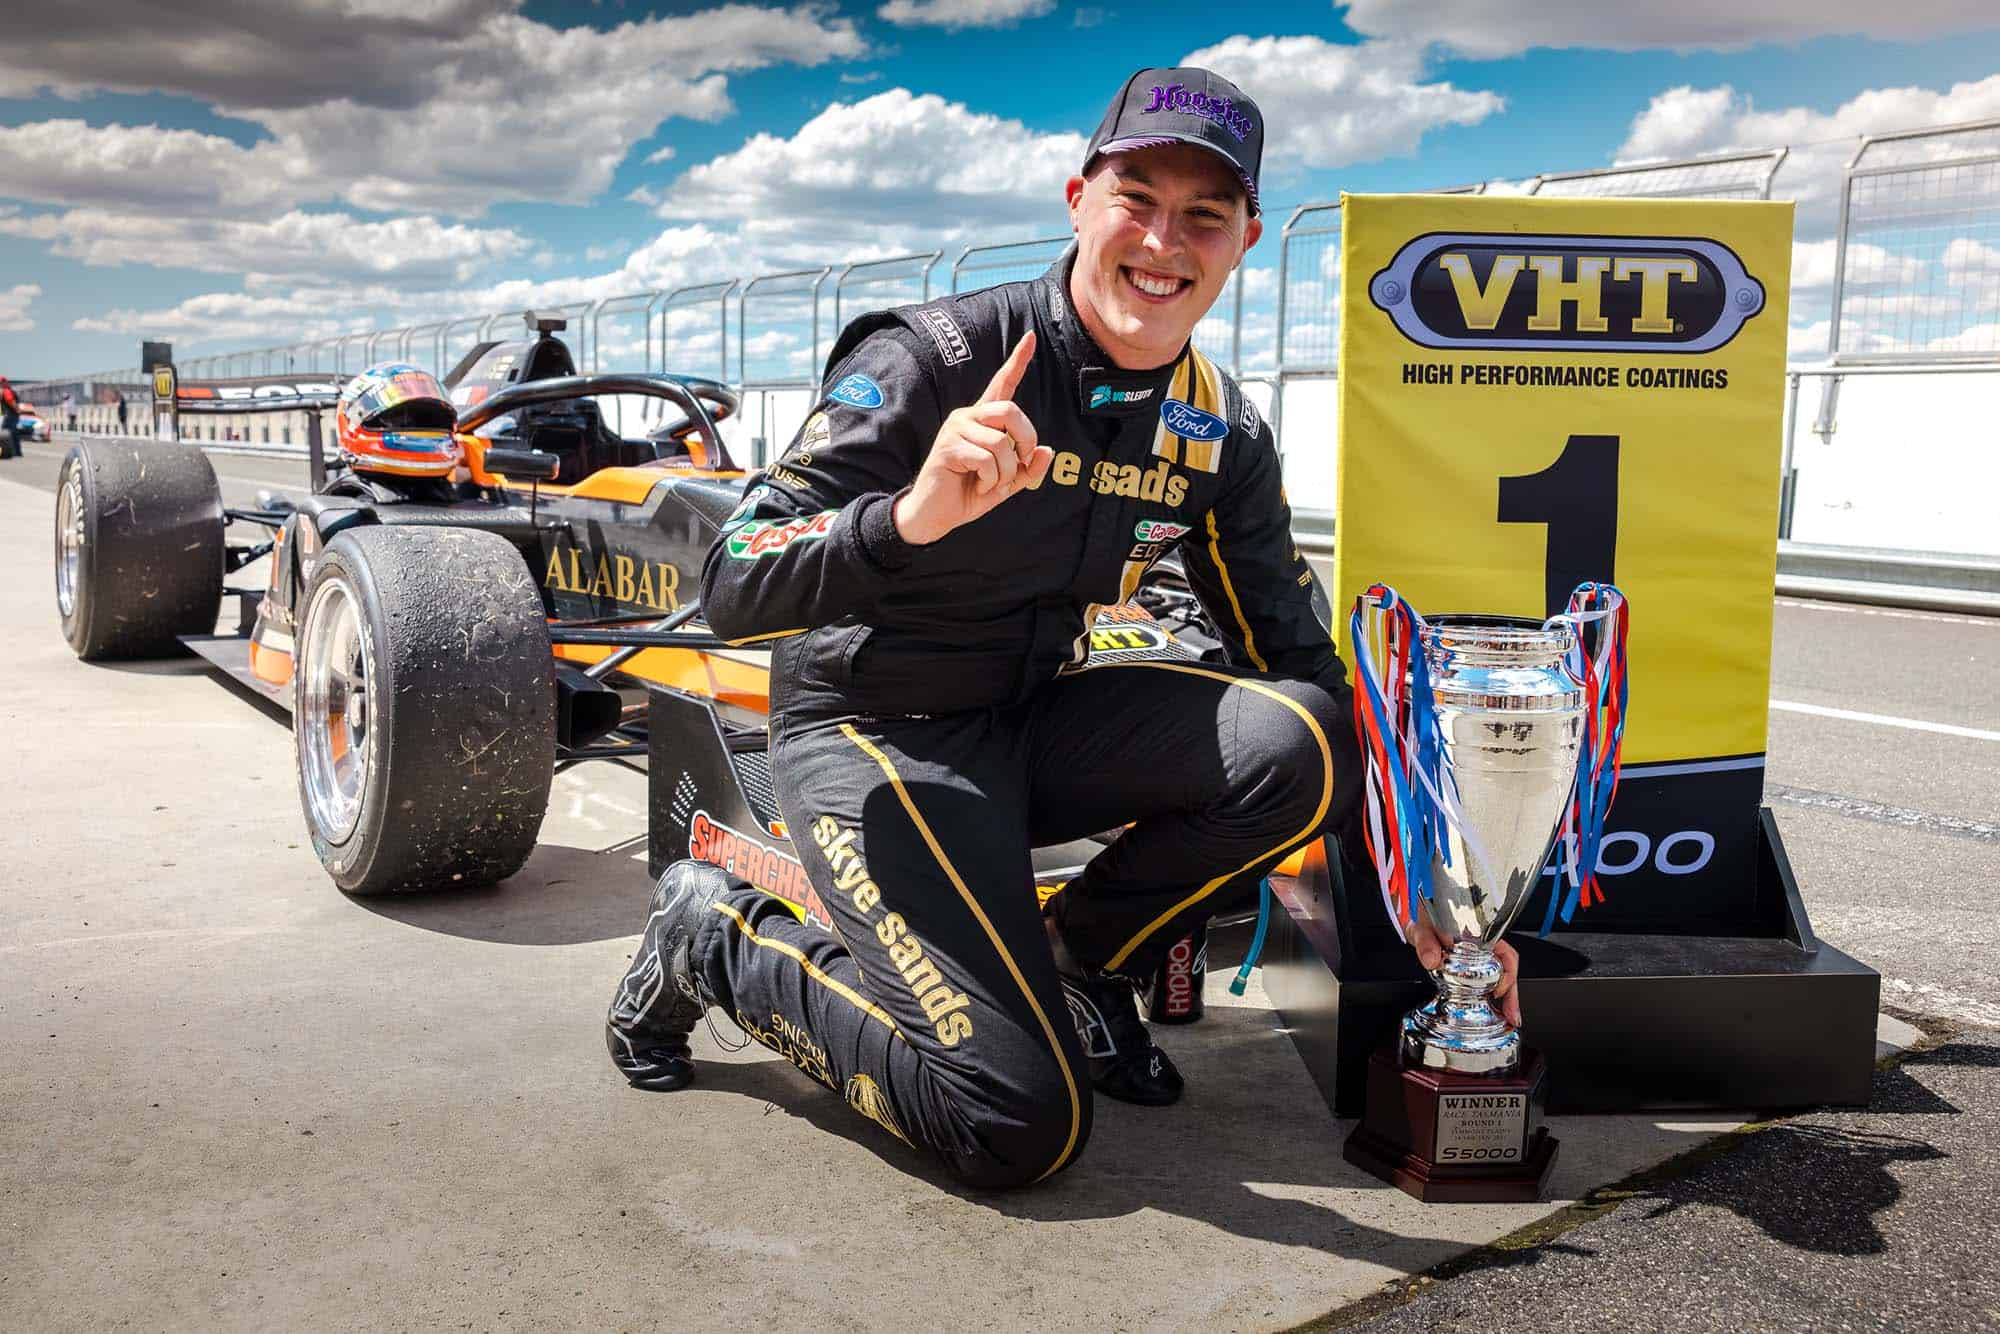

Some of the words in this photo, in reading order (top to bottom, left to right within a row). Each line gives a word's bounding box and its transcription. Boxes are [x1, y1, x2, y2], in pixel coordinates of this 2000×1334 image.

[1440, 253, 1698, 334] VHT
[1401, 363, 1454, 385] HIGH
[1460, 364, 1620, 388] PERFORMANCE
[1626, 367, 1729, 390] COATINGS
[1168, 404, 1211, 437] Ford
[543, 544, 681, 613] ALABAR
[1497, 434, 1621, 706] 1
[1091, 629, 1152, 651] HT
[812, 815, 882, 914] skye
[874, 911, 974, 1047] sands
[1445, 1097, 1521, 1109] WINNER
[1460, 1119, 1495, 1127] ROUND
[1441, 1147, 1518, 1160] S5000
